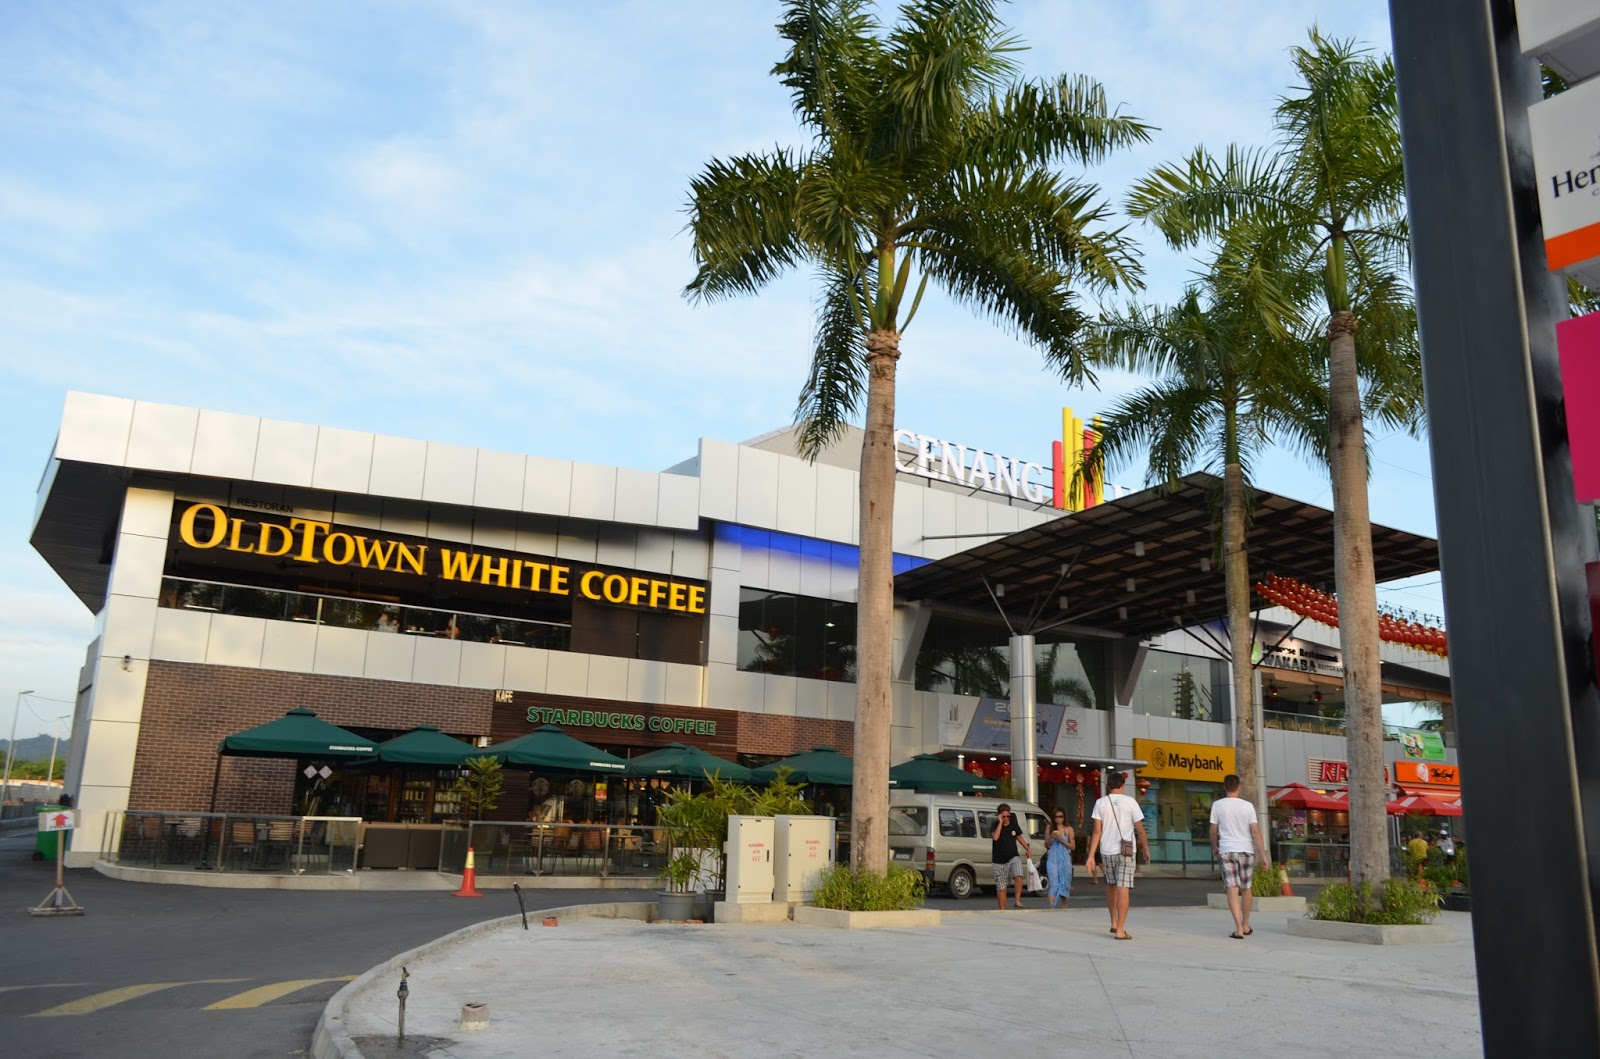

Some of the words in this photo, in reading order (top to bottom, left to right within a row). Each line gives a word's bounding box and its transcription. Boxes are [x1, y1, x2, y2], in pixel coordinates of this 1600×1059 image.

[894, 429, 1044, 503] CENANG
[237, 497, 293, 513] RESTORAN
[441, 548, 570, 596] WHITE
[580, 570, 706, 614] COFFEE
[1263, 654, 1317, 673] WAKABA
[495, 689, 513, 703] KAFE
[526, 706, 646, 731] STARBUCKS
[648, 716, 717, 736] COFFEE
[1168, 753, 1224, 772] Maybank
